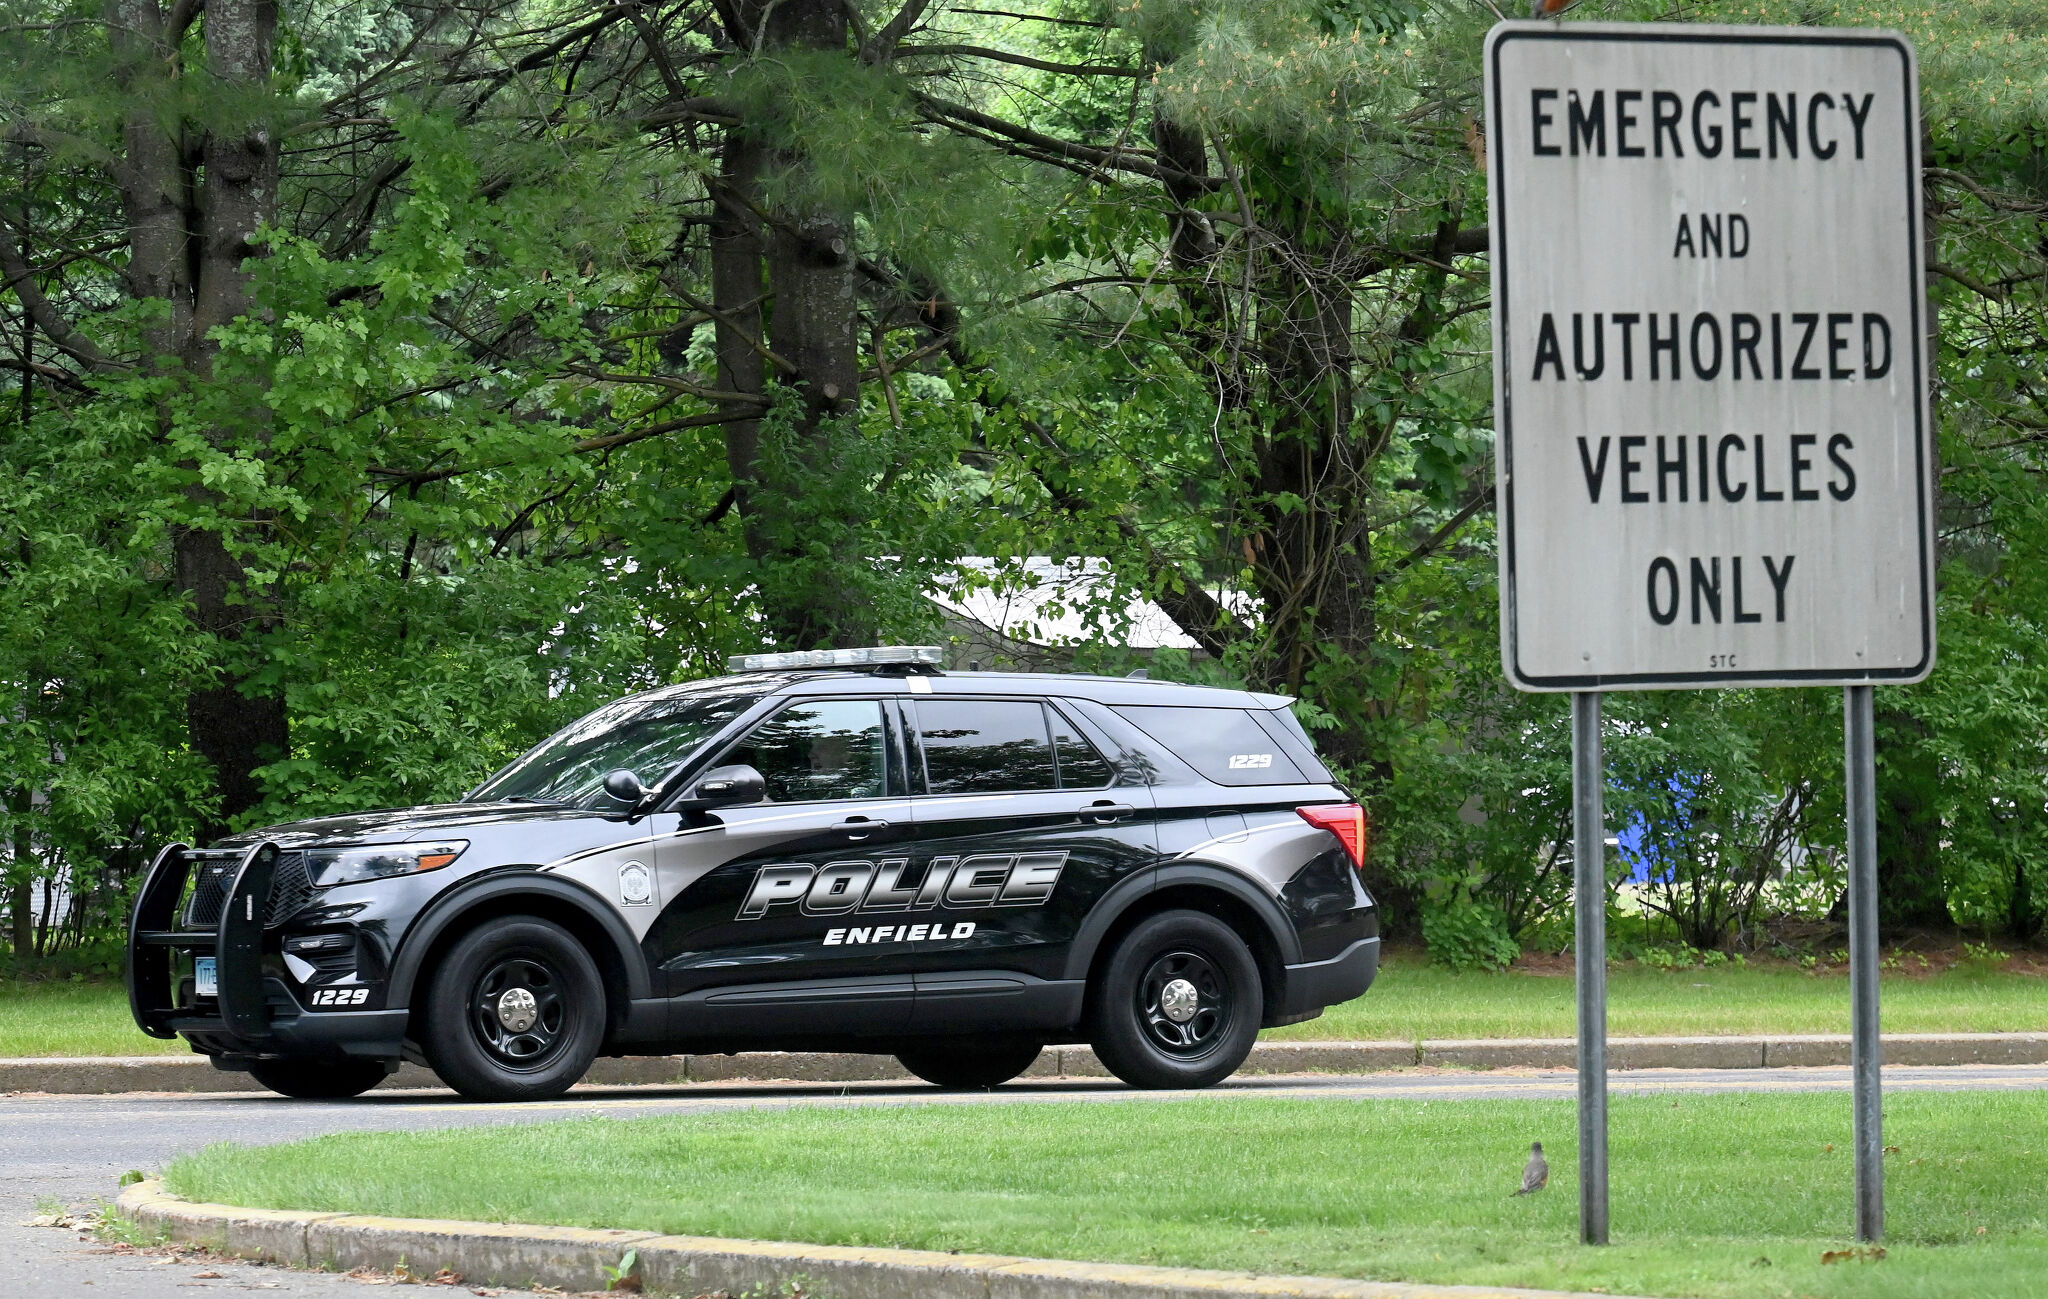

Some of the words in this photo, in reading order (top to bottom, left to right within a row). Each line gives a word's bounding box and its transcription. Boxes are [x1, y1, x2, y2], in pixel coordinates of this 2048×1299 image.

[1532, 89, 1874, 160] EMERGENCY
[1674, 214, 1749, 258] AND
[1532, 312, 1891, 381] AUTHORIZED
[1577, 433, 1856, 503] VEHICLES
[1648, 556, 1795, 625] ONLY
[1709, 655, 1737, 668] STC
[1228, 754, 1273, 769] 1229
[734, 850, 1070, 921] POLICE
[823, 922, 976, 946] ENFIELD
[311, 988, 370, 1006] 1229
